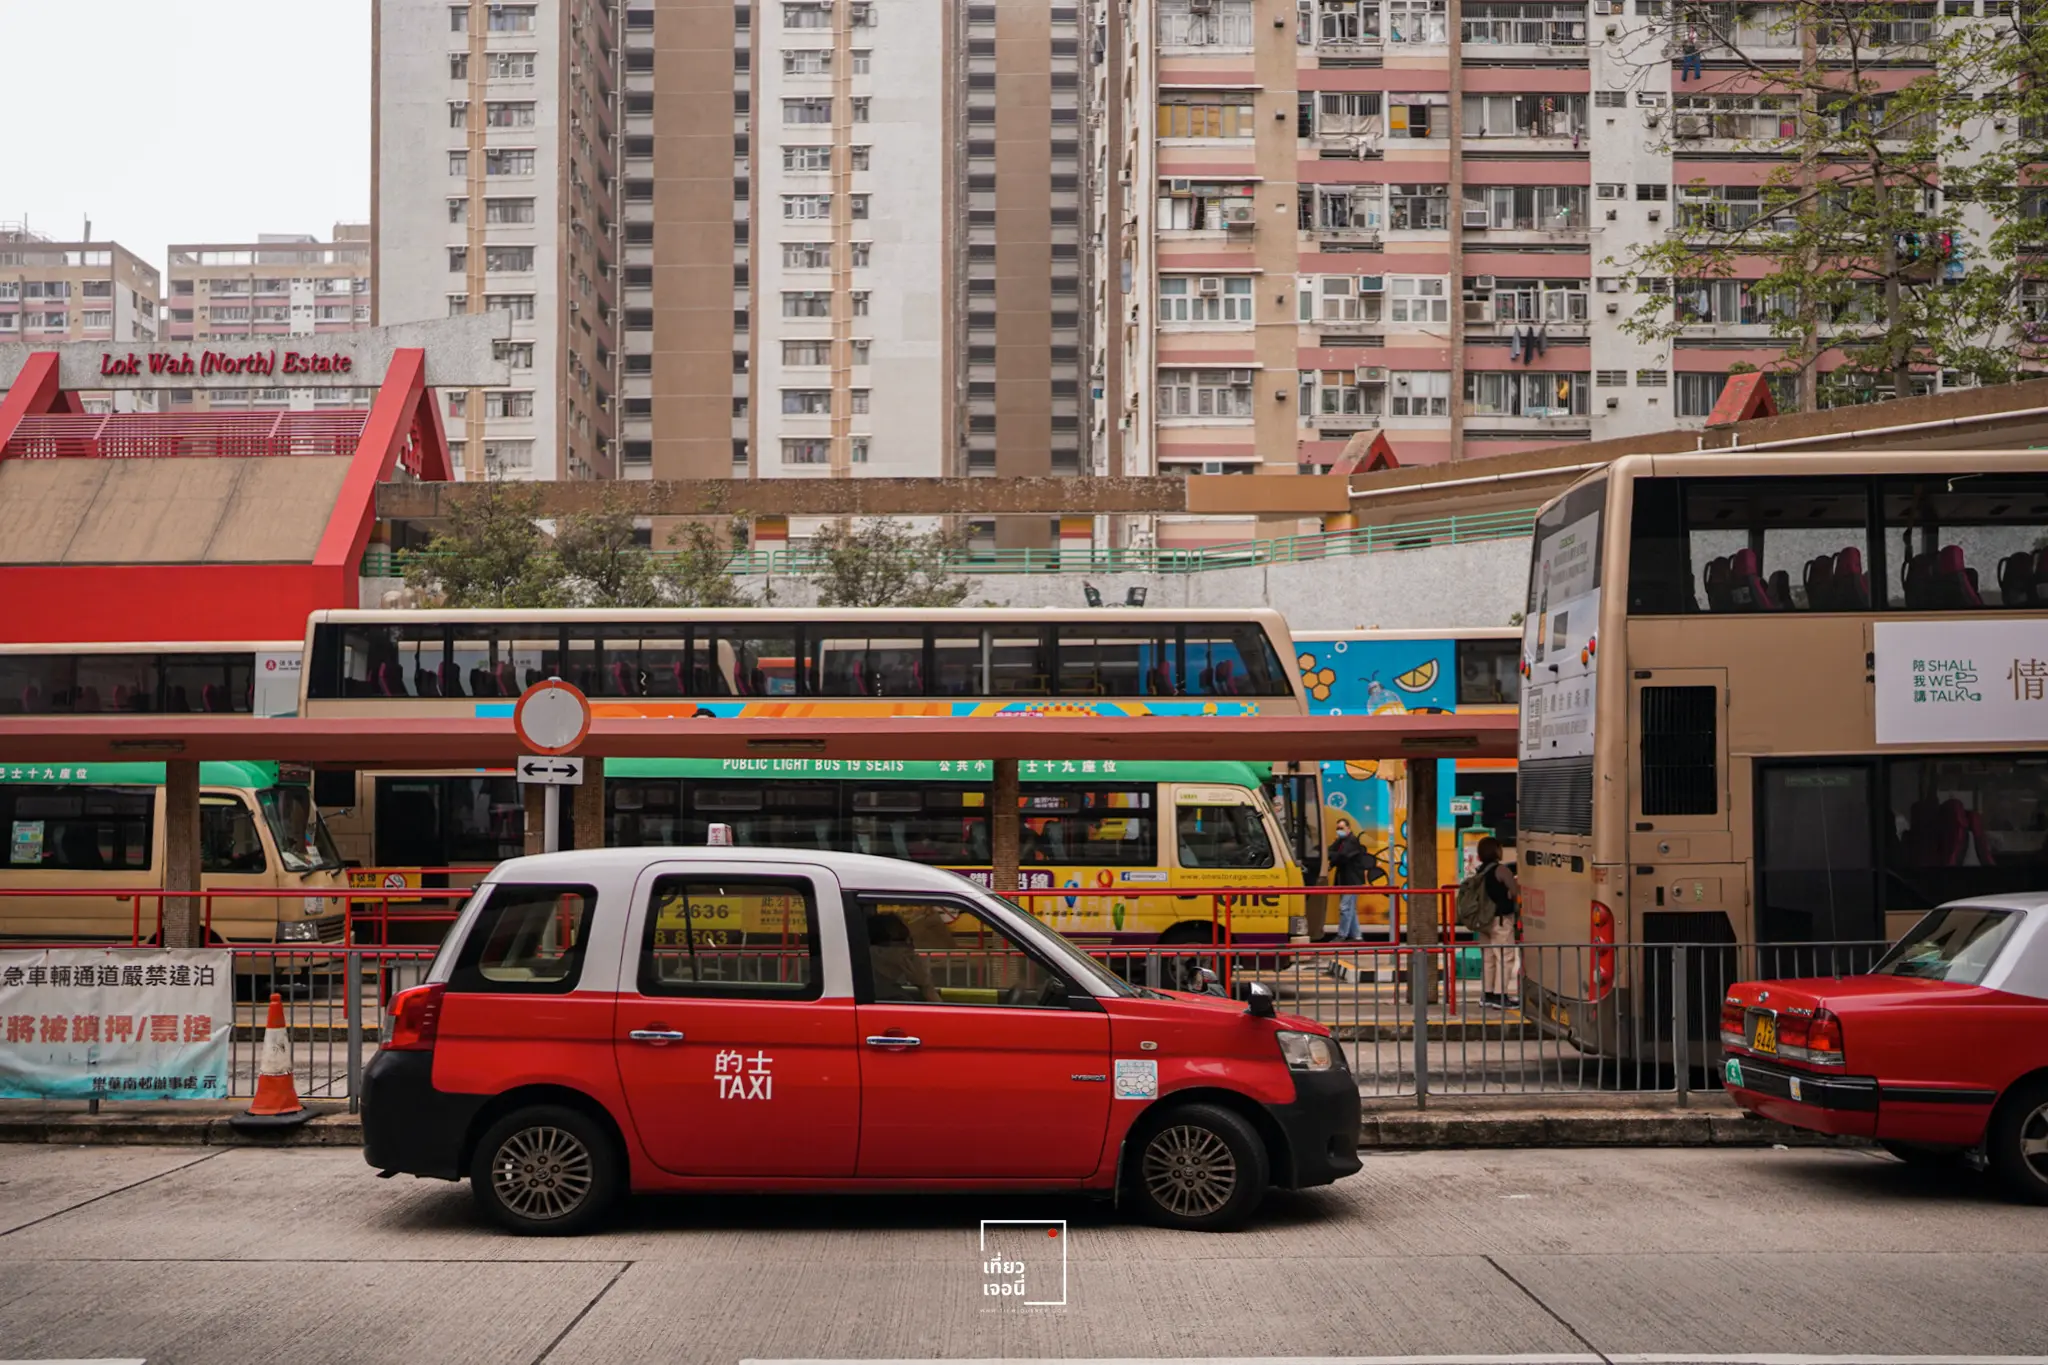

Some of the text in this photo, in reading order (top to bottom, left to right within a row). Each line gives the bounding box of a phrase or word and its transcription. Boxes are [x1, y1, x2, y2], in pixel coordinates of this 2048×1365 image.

[100, 350, 352, 376] Lok Wah (North) Estate
[1913, 660, 1977, 672] 陪 SHALL
[1914, 675, 1954, 687] 我 WE
[1914, 690, 1966, 703] 講 TALK
[723, 758, 904, 772] PUBLIC LIGHT BUS 19 SEATS
[0, 965, 214, 987] 急車輛通道嚴禁違泊
[715, 1049, 773, 1074] 的士
[203, 1075, 217, 1089] 示
[714, 1075, 772, 1100] TAXI
